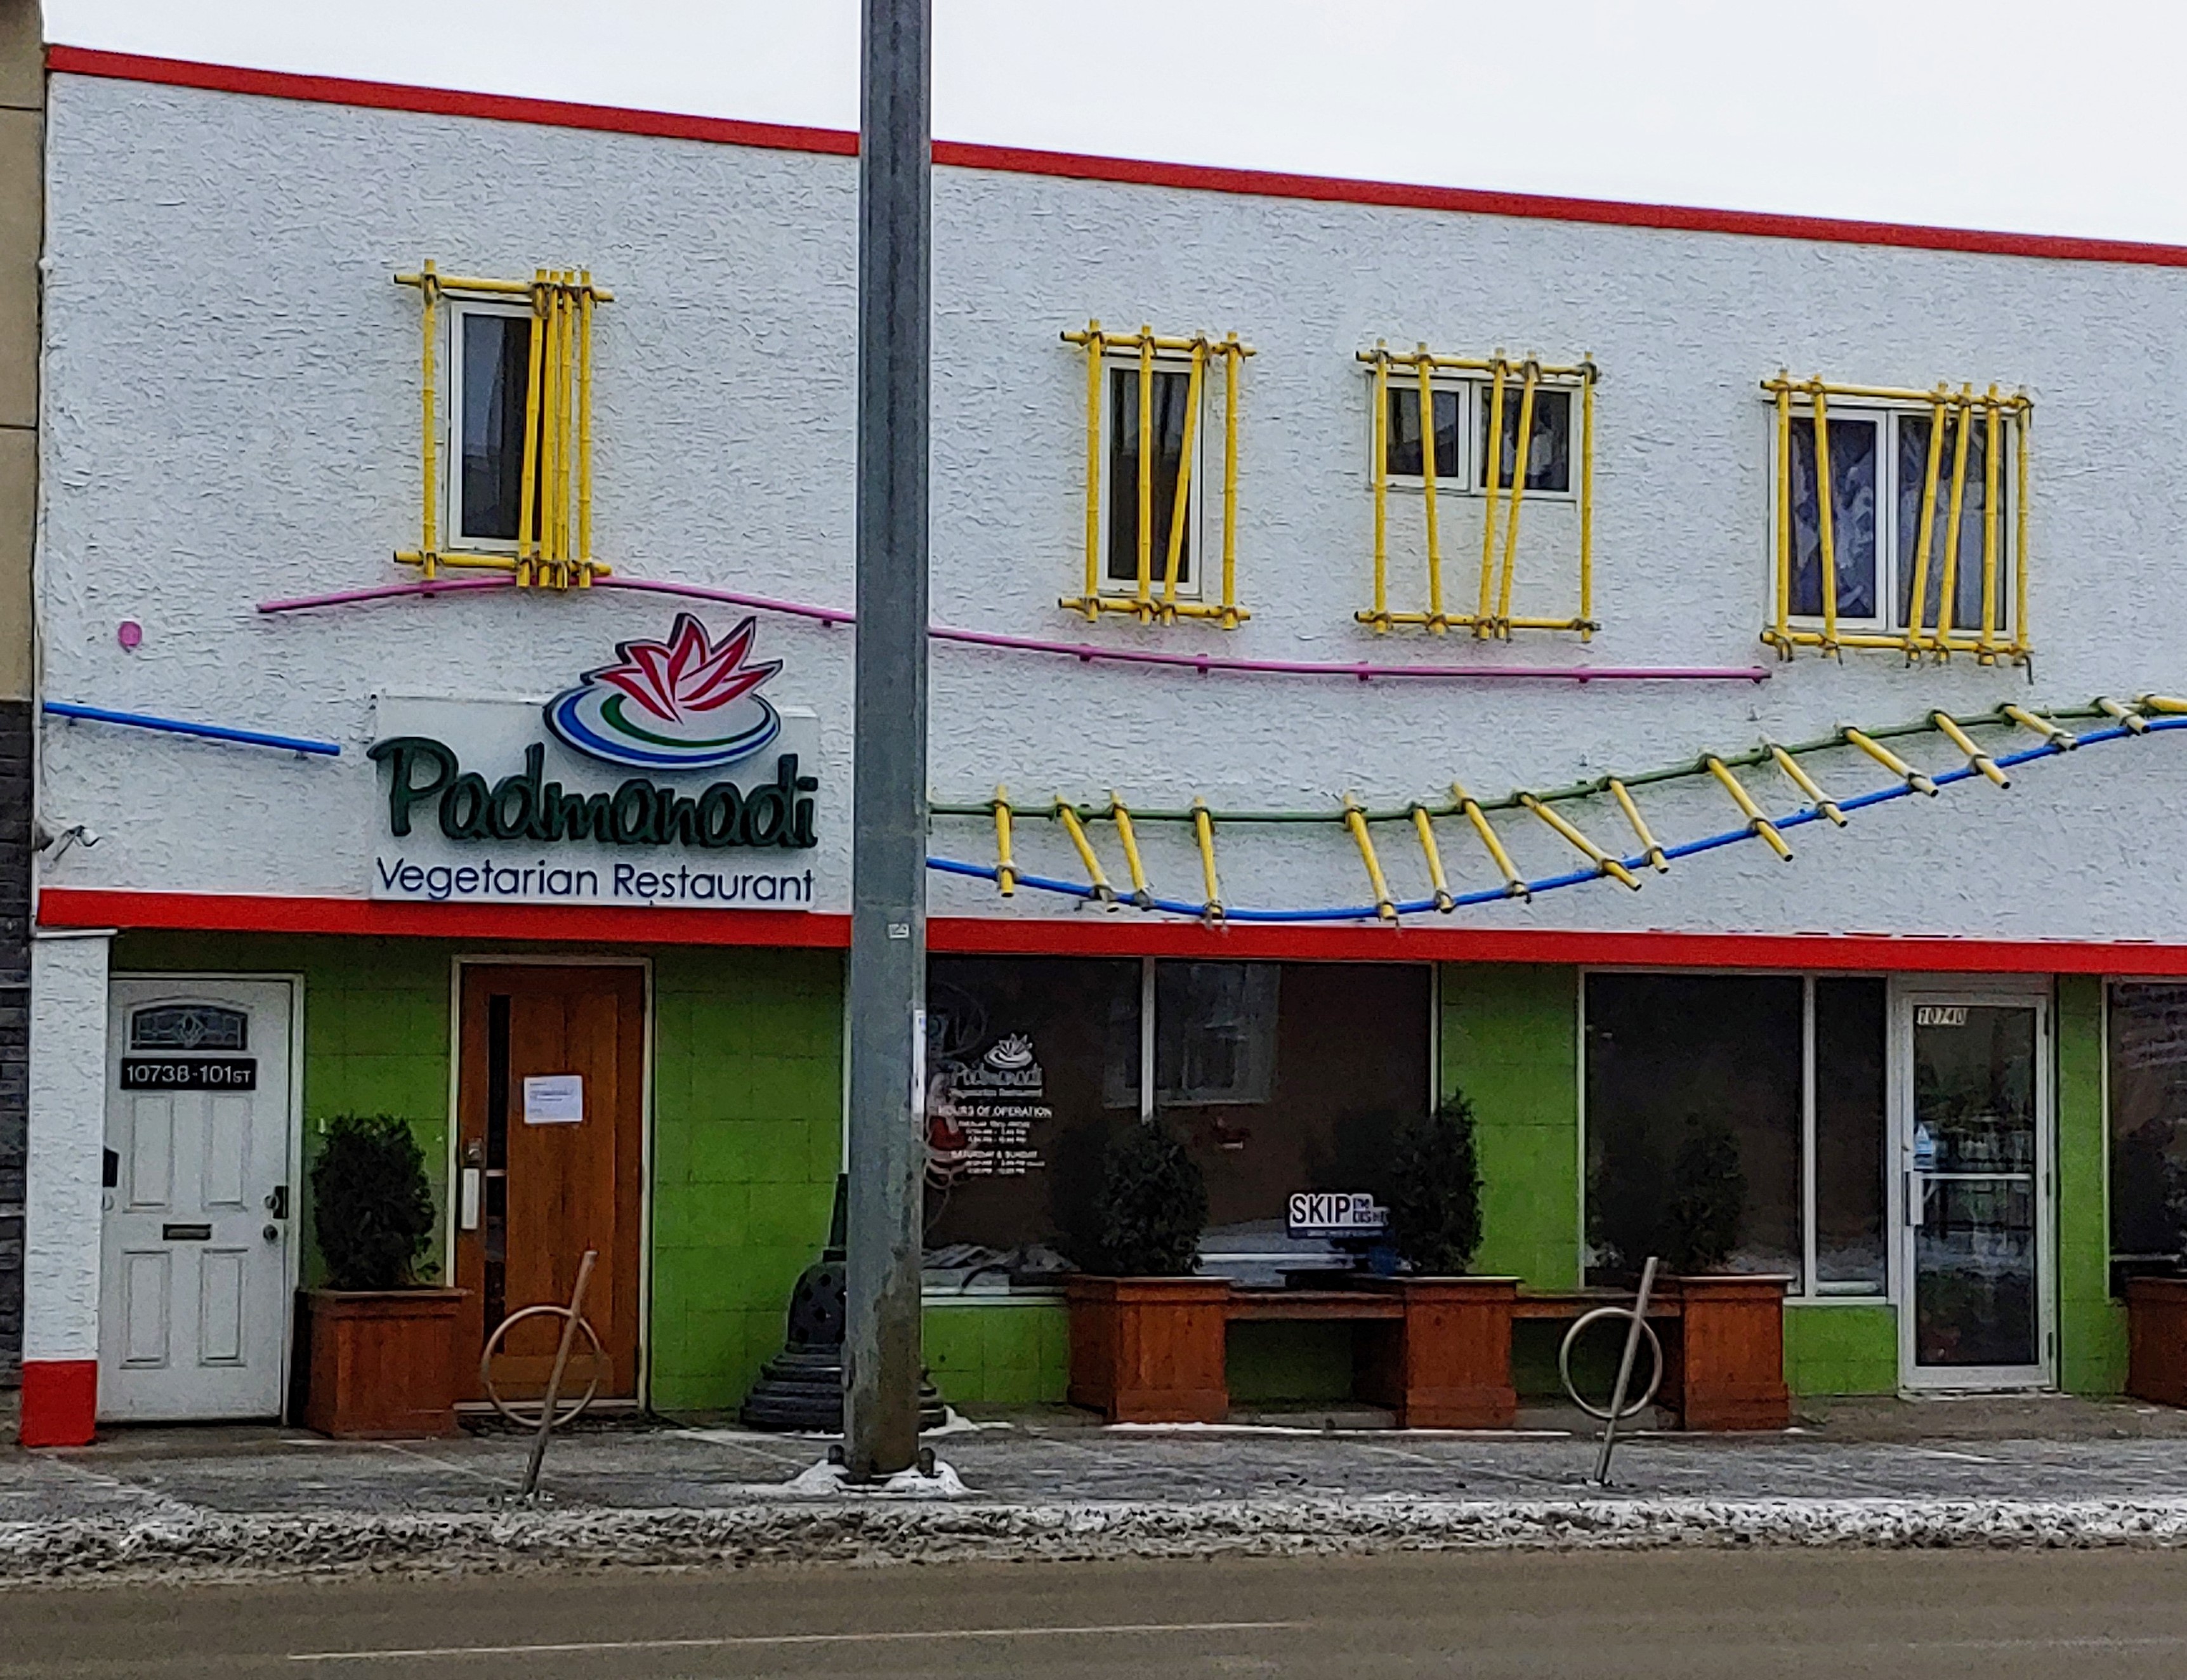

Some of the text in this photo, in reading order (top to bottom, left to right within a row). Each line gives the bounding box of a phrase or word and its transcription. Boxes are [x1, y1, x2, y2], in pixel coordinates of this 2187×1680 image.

[367, 737, 818, 848] Padmanadi
[376, 857, 817, 903] Vegetarian Restaurant
[976, 1105, 990, 1117] OF
[993, 1105, 1052, 1118] OPERATION
[1292, 1195, 1350, 1224] SKIP
